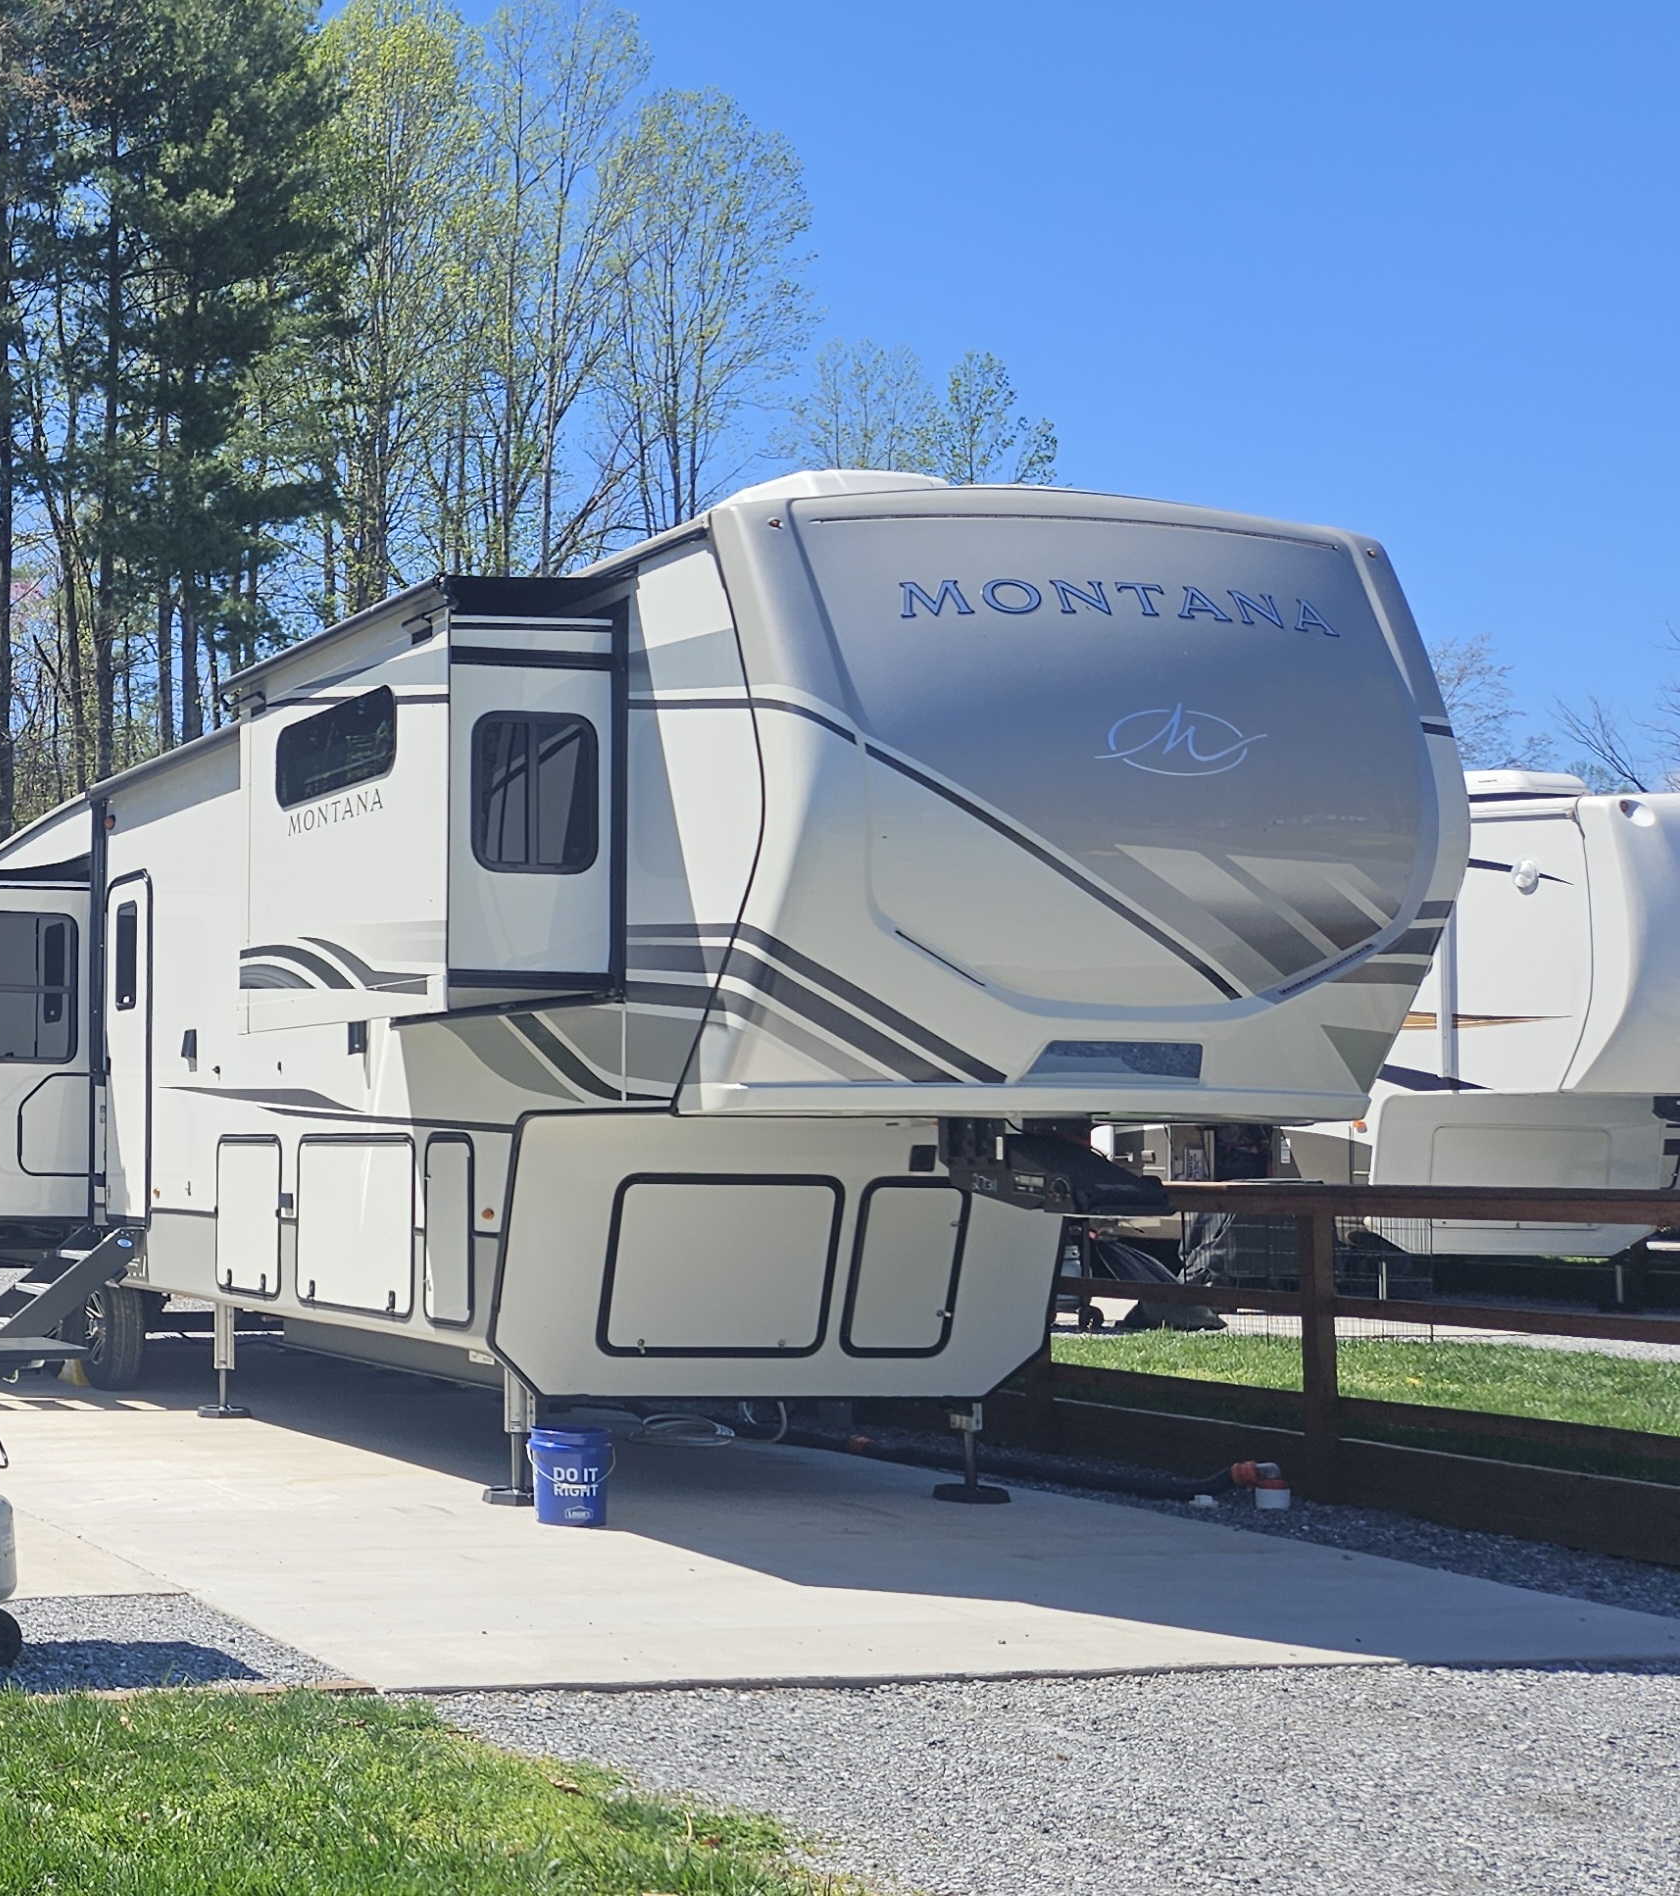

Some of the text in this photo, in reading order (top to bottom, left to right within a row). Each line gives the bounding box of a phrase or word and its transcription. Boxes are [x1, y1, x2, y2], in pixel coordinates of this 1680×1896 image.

[899, 578, 1340, 638] MONTANA
[287, 788, 384, 837] MONTANA
[553, 1466, 599, 1483] DO IT
[553, 1483, 599, 1497] RIGHT
